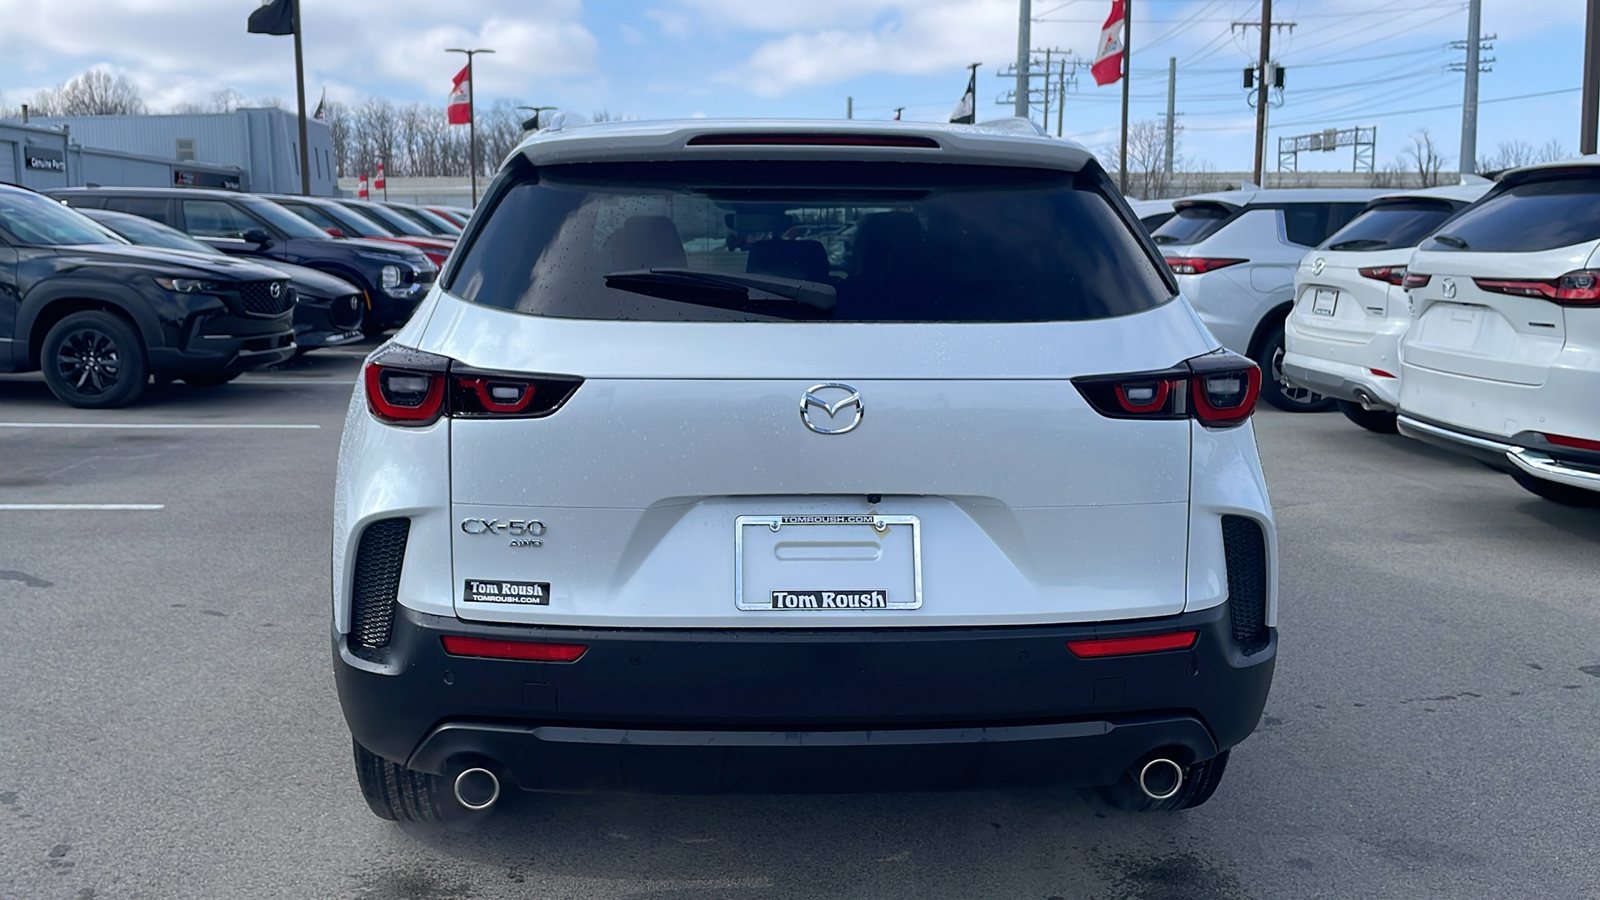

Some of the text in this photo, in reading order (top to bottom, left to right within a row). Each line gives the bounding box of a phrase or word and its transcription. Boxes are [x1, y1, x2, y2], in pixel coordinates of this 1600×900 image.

[461, 517, 547, 536] CX-50
[508, 539, 543, 548] AWD
[470, 582, 543, 596] Tom Roush
[472, 594, 540, 603] TOMROUSH.COM
[773, 591, 886, 608] Tom Roush
